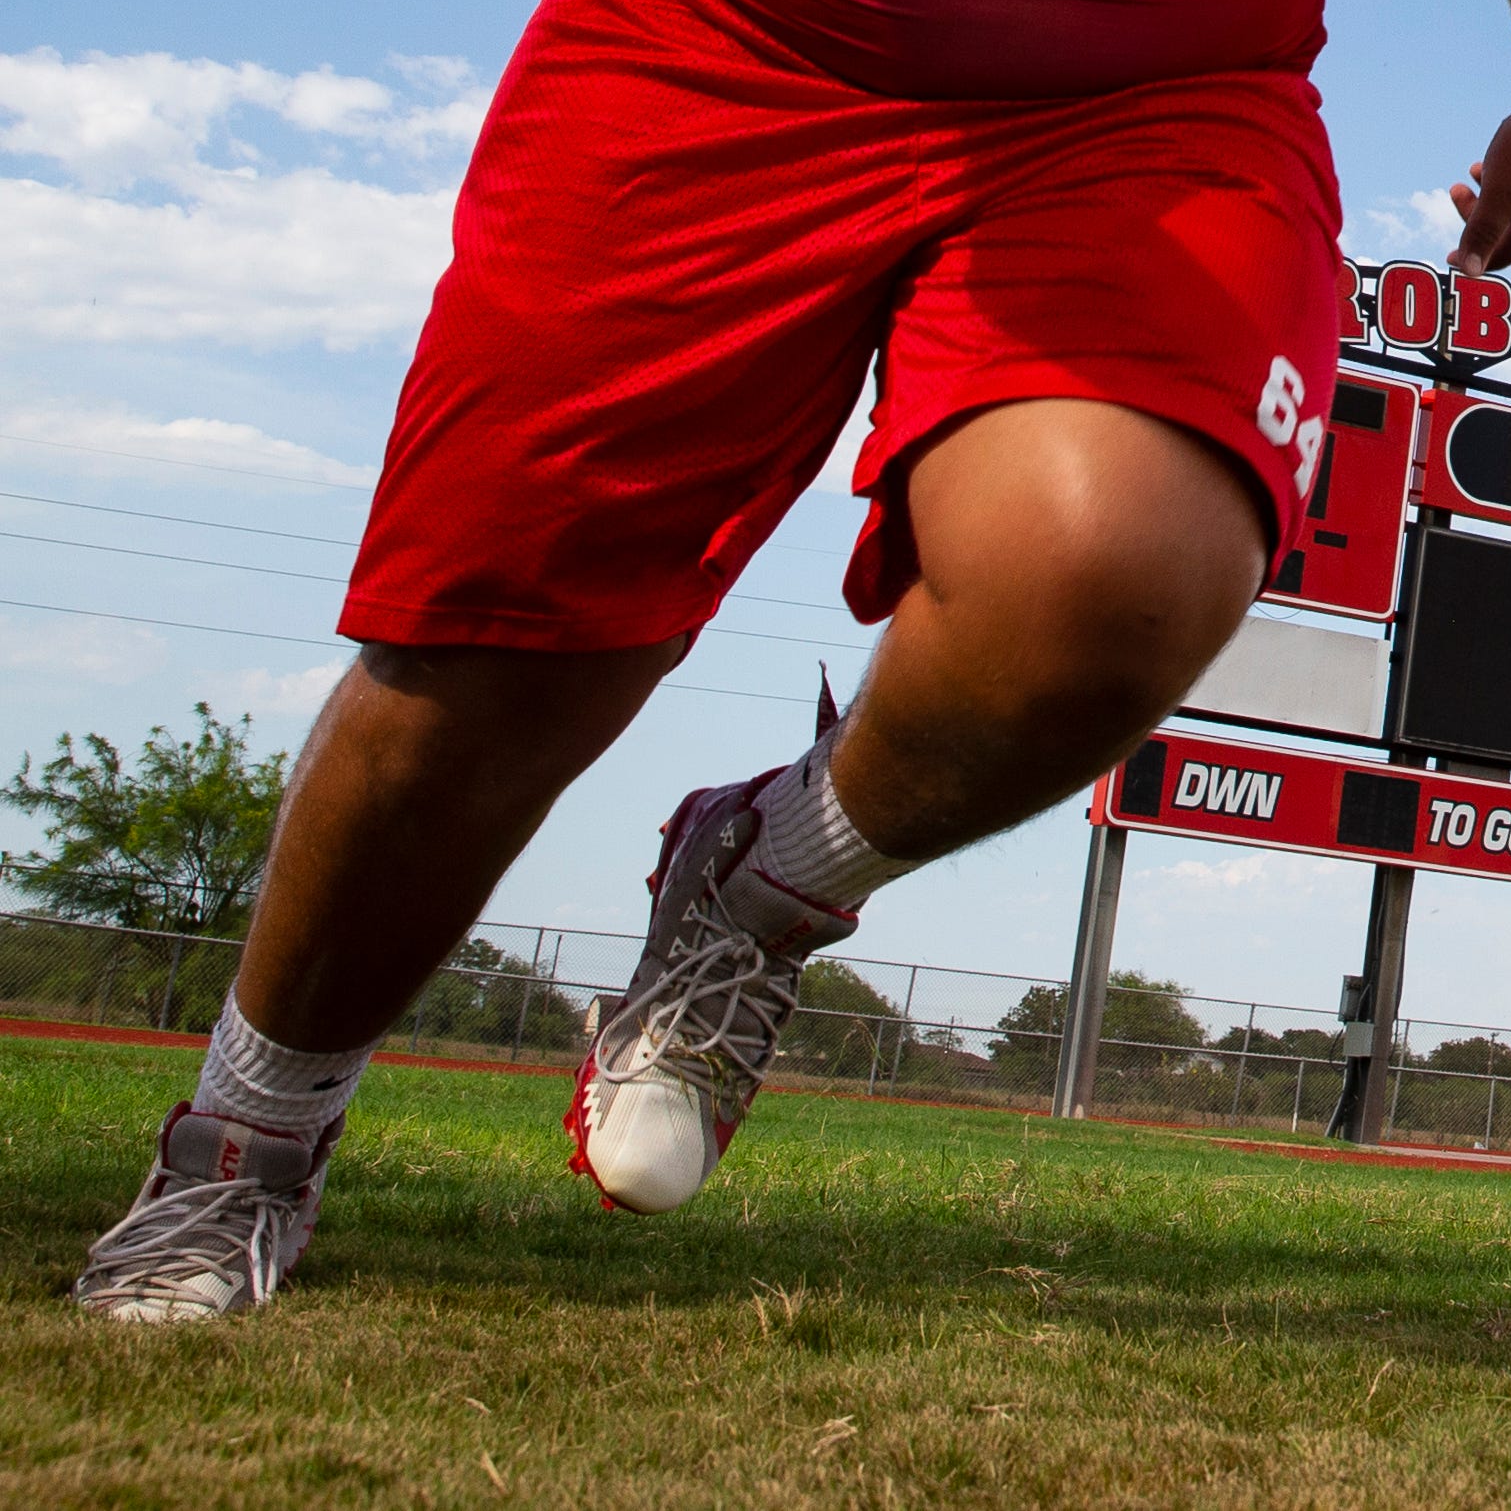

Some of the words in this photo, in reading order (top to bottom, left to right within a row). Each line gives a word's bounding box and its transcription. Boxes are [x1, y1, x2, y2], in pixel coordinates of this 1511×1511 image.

[1171, 759, 1284, 822] DWN
[1426, 796, 1478, 849] TO
[765, 918, 813, 954] ALPH
[219, 1138, 241, 1182] ALP
